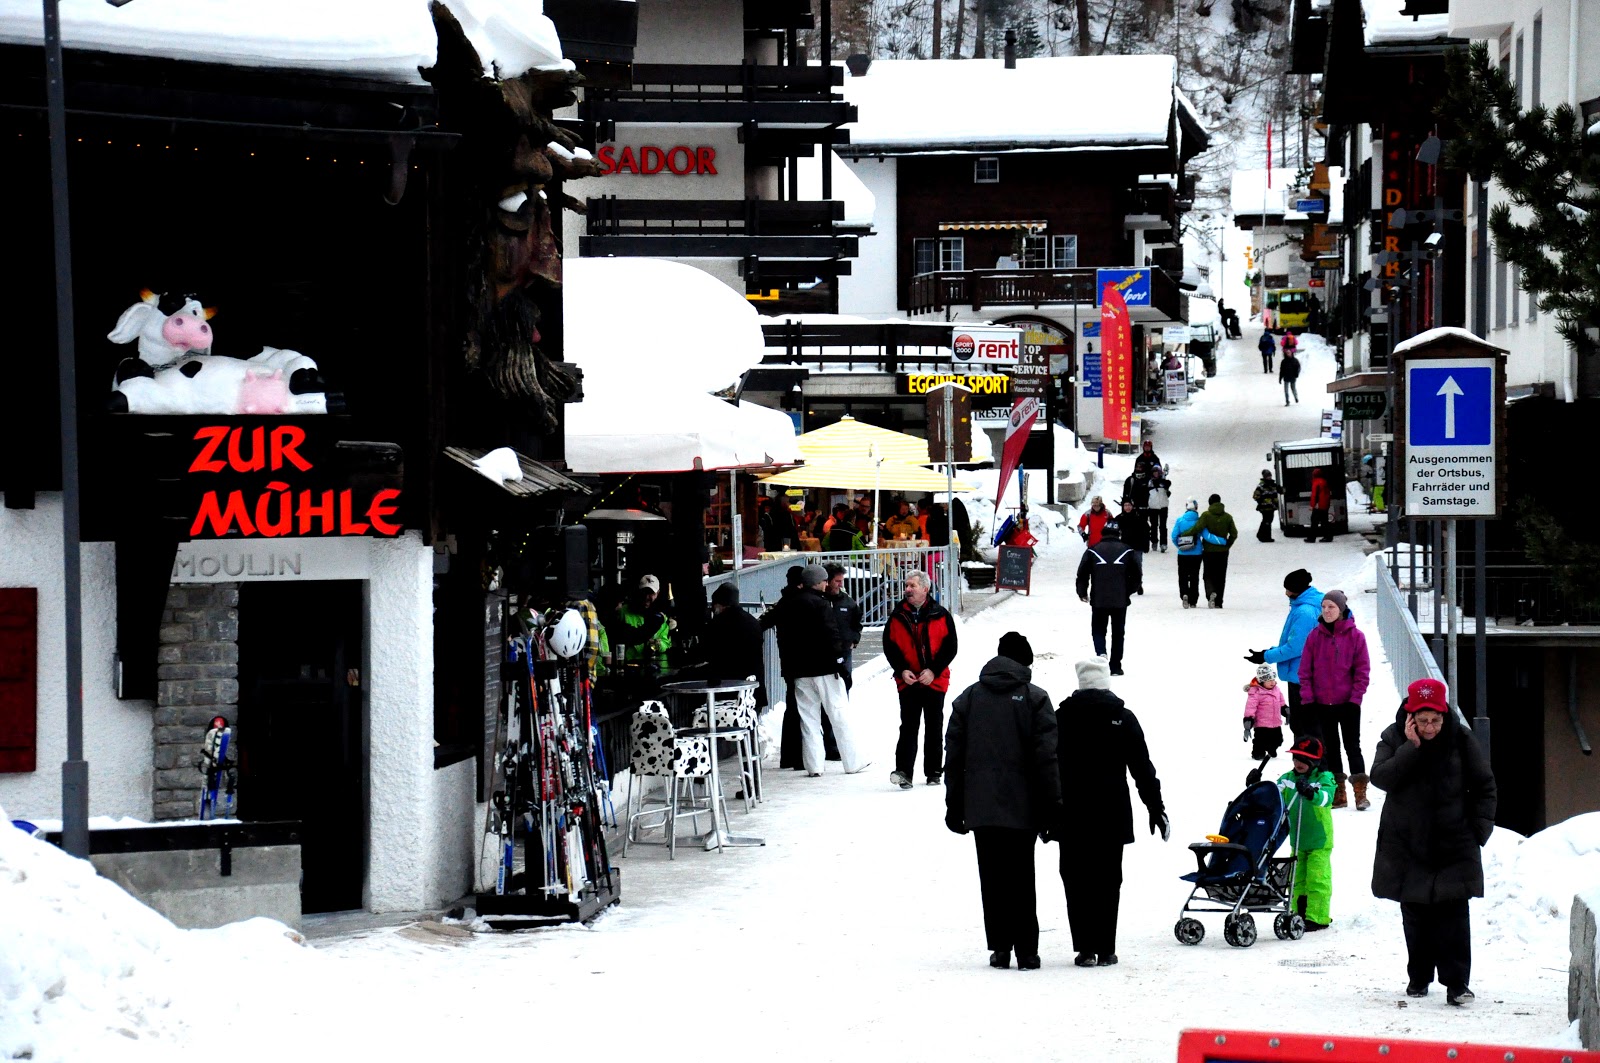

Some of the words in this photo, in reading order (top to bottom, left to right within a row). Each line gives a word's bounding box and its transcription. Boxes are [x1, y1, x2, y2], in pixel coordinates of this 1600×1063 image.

[978, 339, 1019, 359] rent
[1012, 364, 1048, 376] SERVICE
[968, 375, 1010, 395] SPORT
[1345, 395, 1384, 404] HOTEL
[978, 408, 1044, 419] RESTAT
[1021, 397, 1038, 419] rent
[188, 425, 313, 473] ZUR
[1409, 454, 1493, 466] Ausgenommen
[1416, 468, 1435, 478] der
[1437, 468, 1485, 479] Ortsbus,
[1412, 482, 1466, 492] Fahrräder
[1468, 481, 1490, 491] und
[1422, 496, 1480, 508] Samstage.
[173, 553, 301, 577] MOULIN
